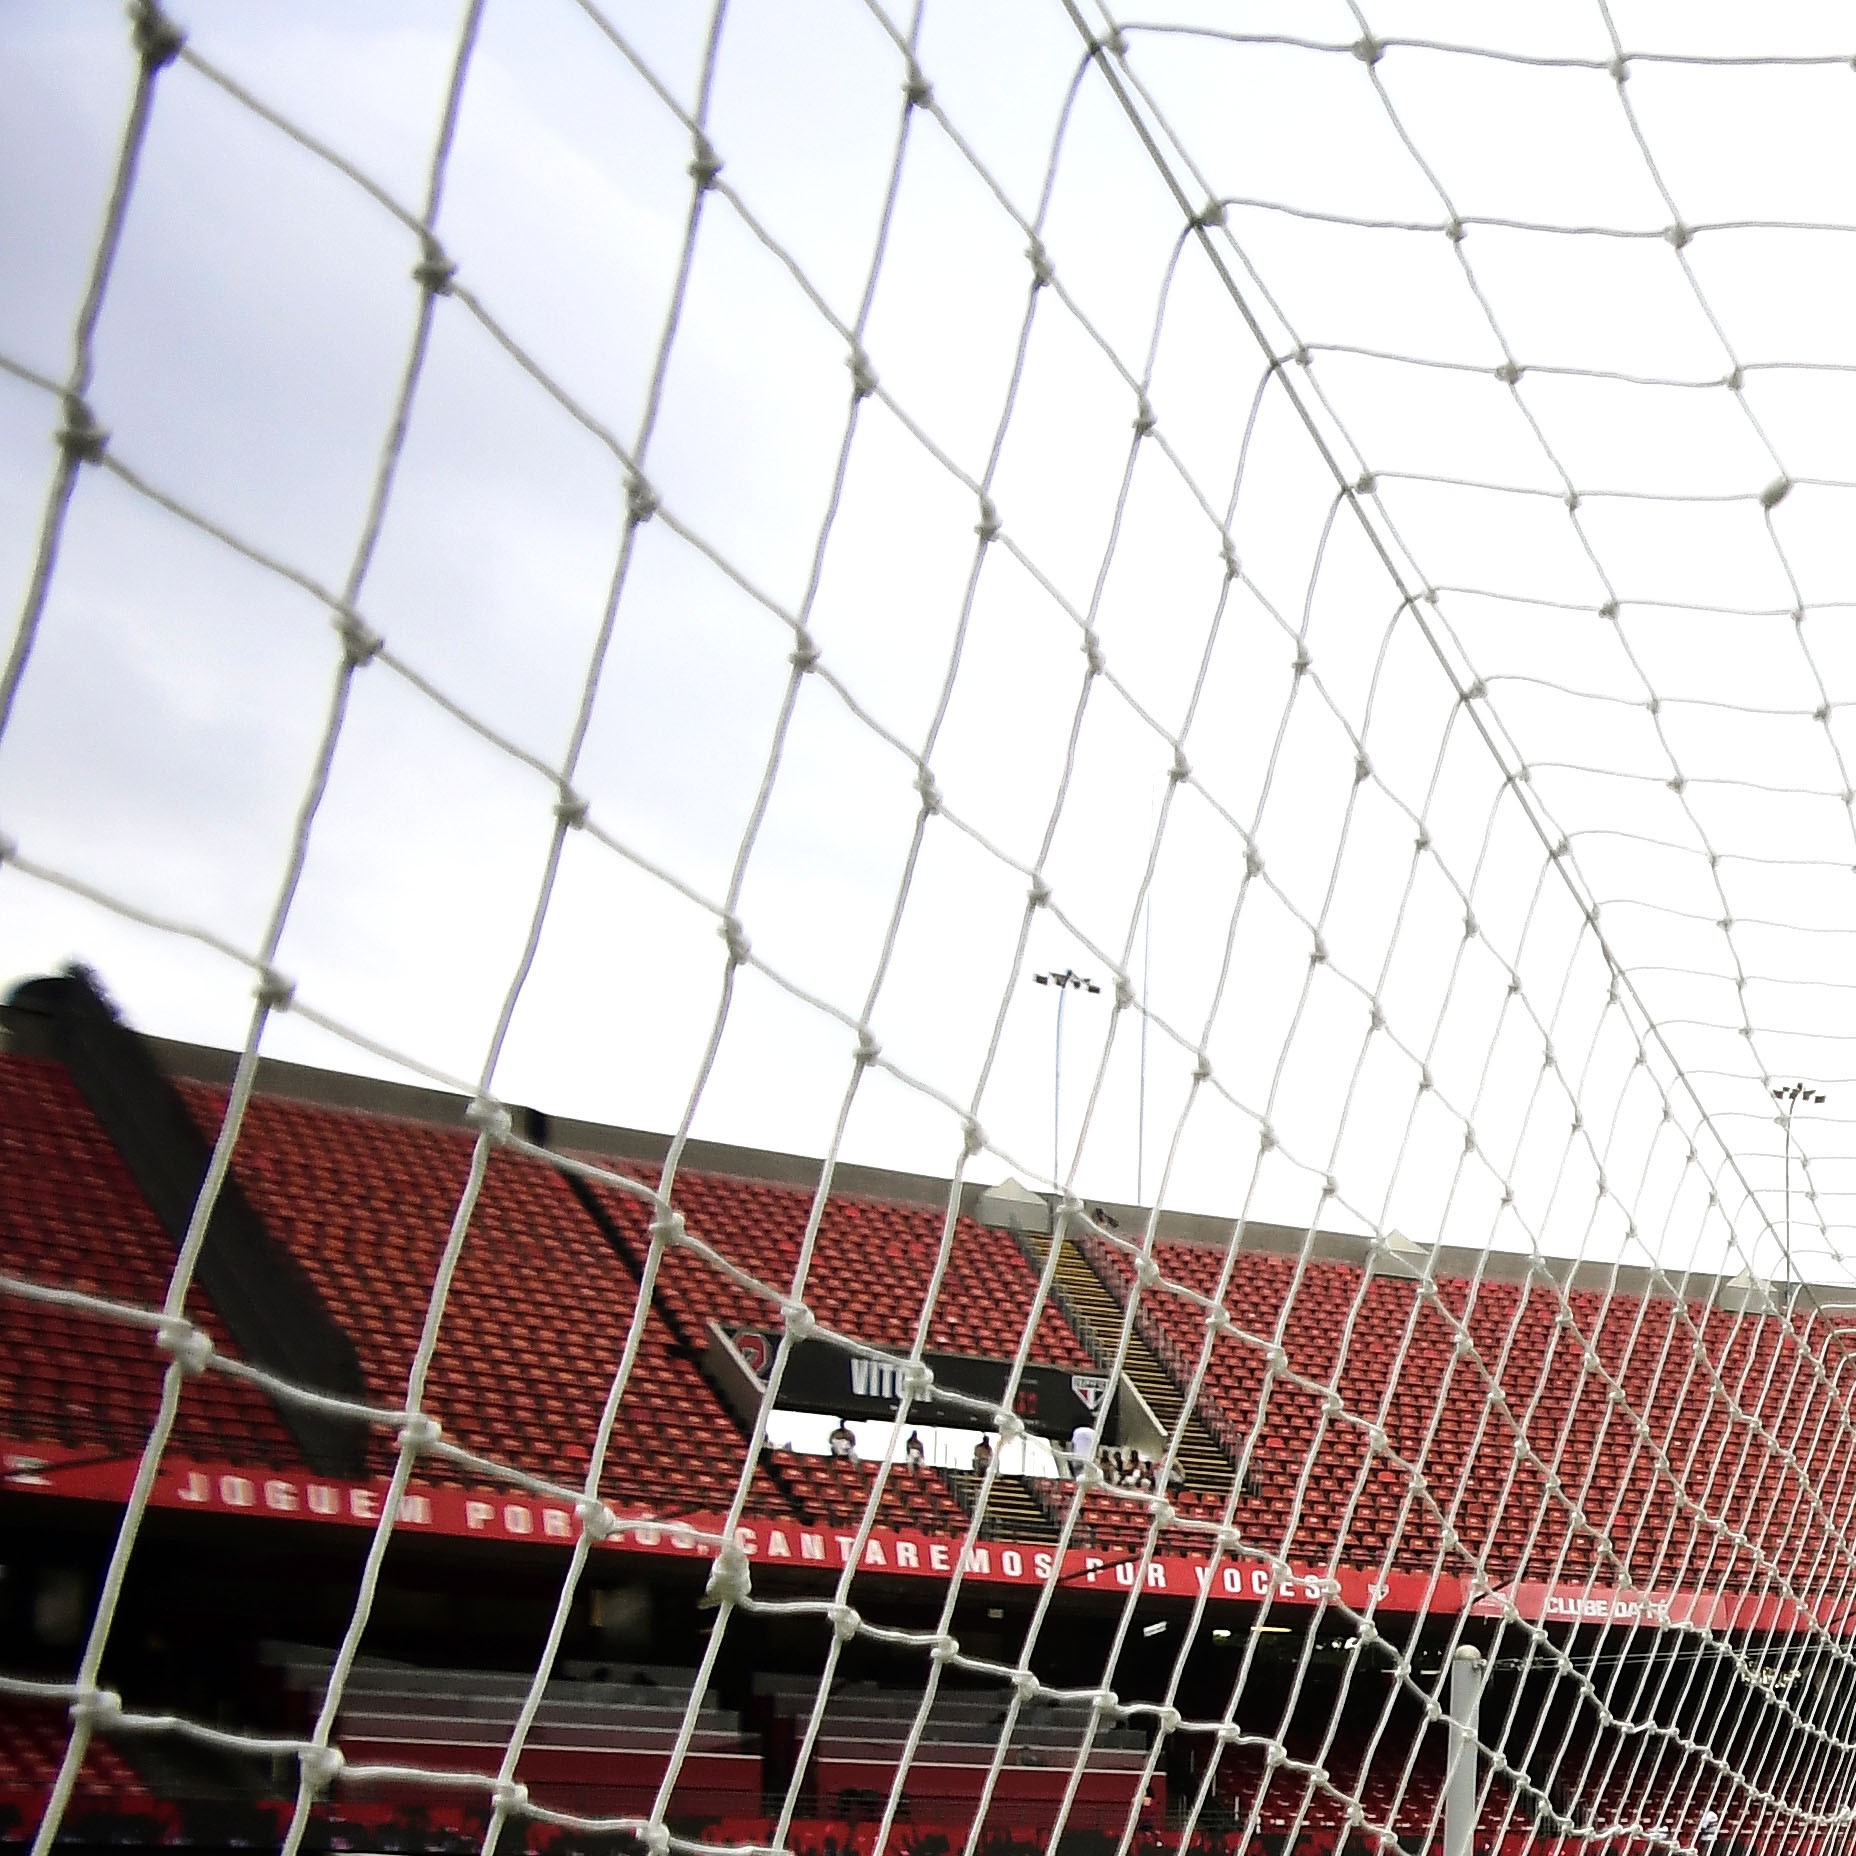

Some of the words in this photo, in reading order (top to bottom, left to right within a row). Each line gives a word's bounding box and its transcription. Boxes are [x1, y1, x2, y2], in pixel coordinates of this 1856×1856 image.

[178, 1471, 432, 1525] JOGUEM
[466, 1500, 573, 1538] POR
[733, 1526, 1054, 1580] CANTAREMOS
[1547, 1597, 1609, 1617] CLUBE
